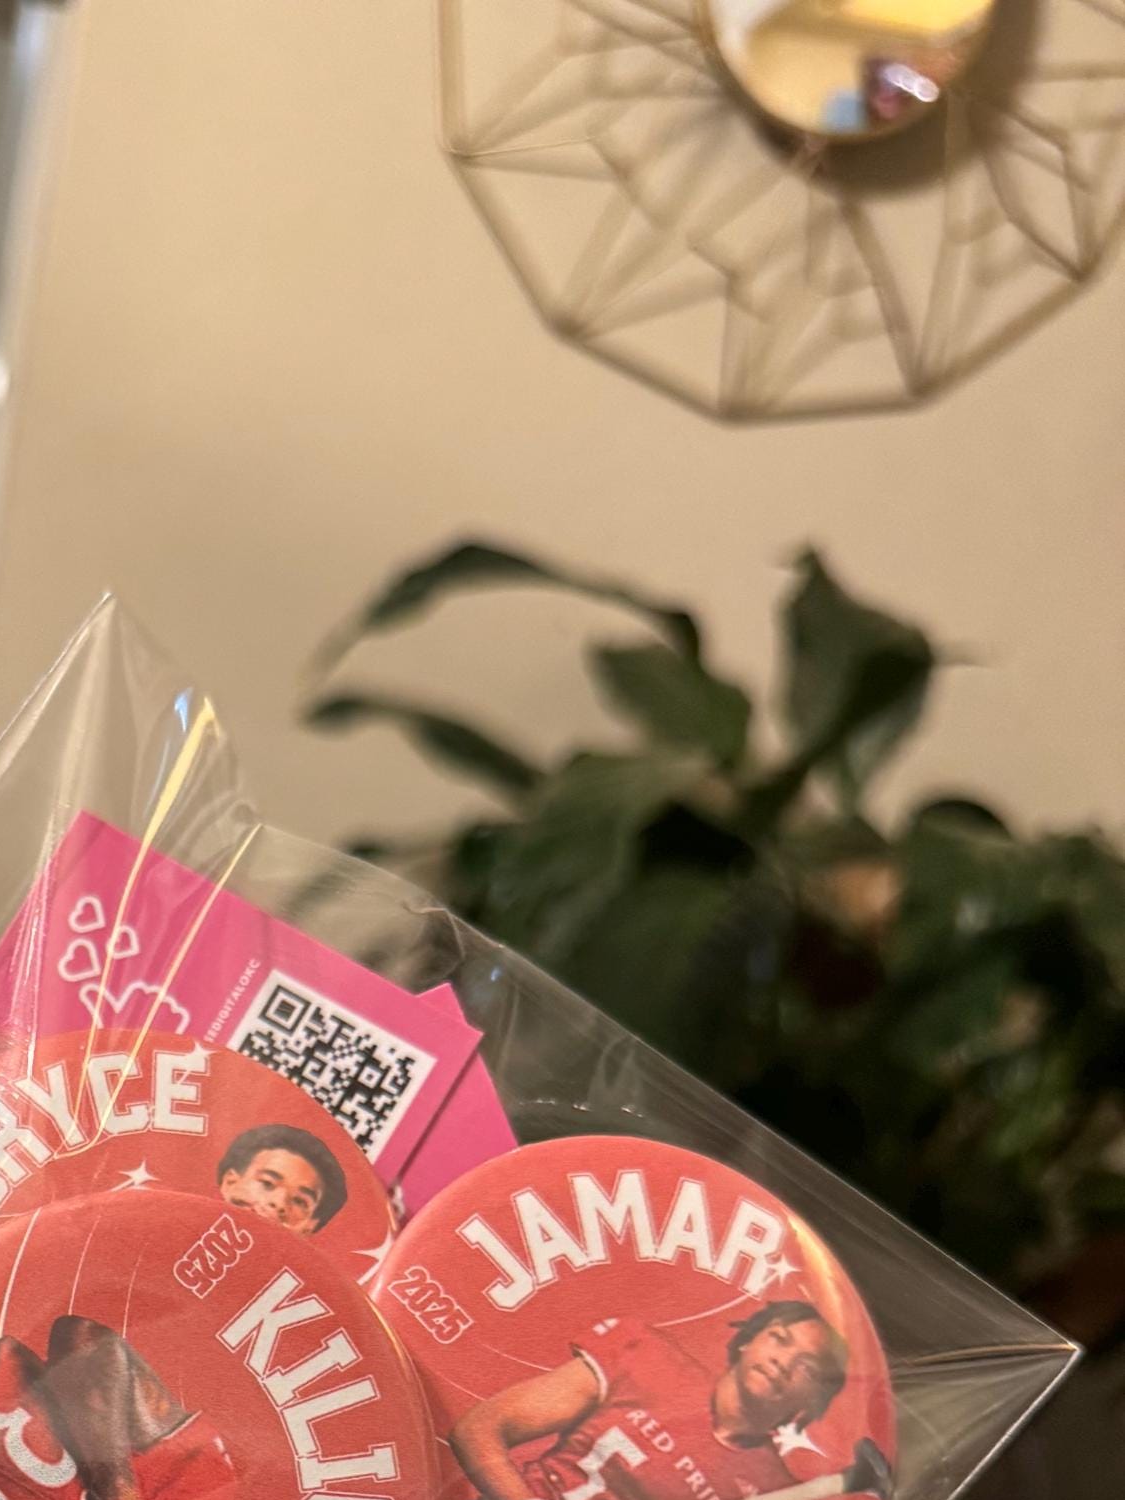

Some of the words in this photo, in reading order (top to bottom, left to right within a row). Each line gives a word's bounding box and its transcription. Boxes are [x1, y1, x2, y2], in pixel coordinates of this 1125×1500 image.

[174, 1214, 253, 1297] 2025
[456, 1170, 789, 1312] JAMAR
[388, 1266, 473, 1344] 2025
[626, 1409, 674, 1453] RED
